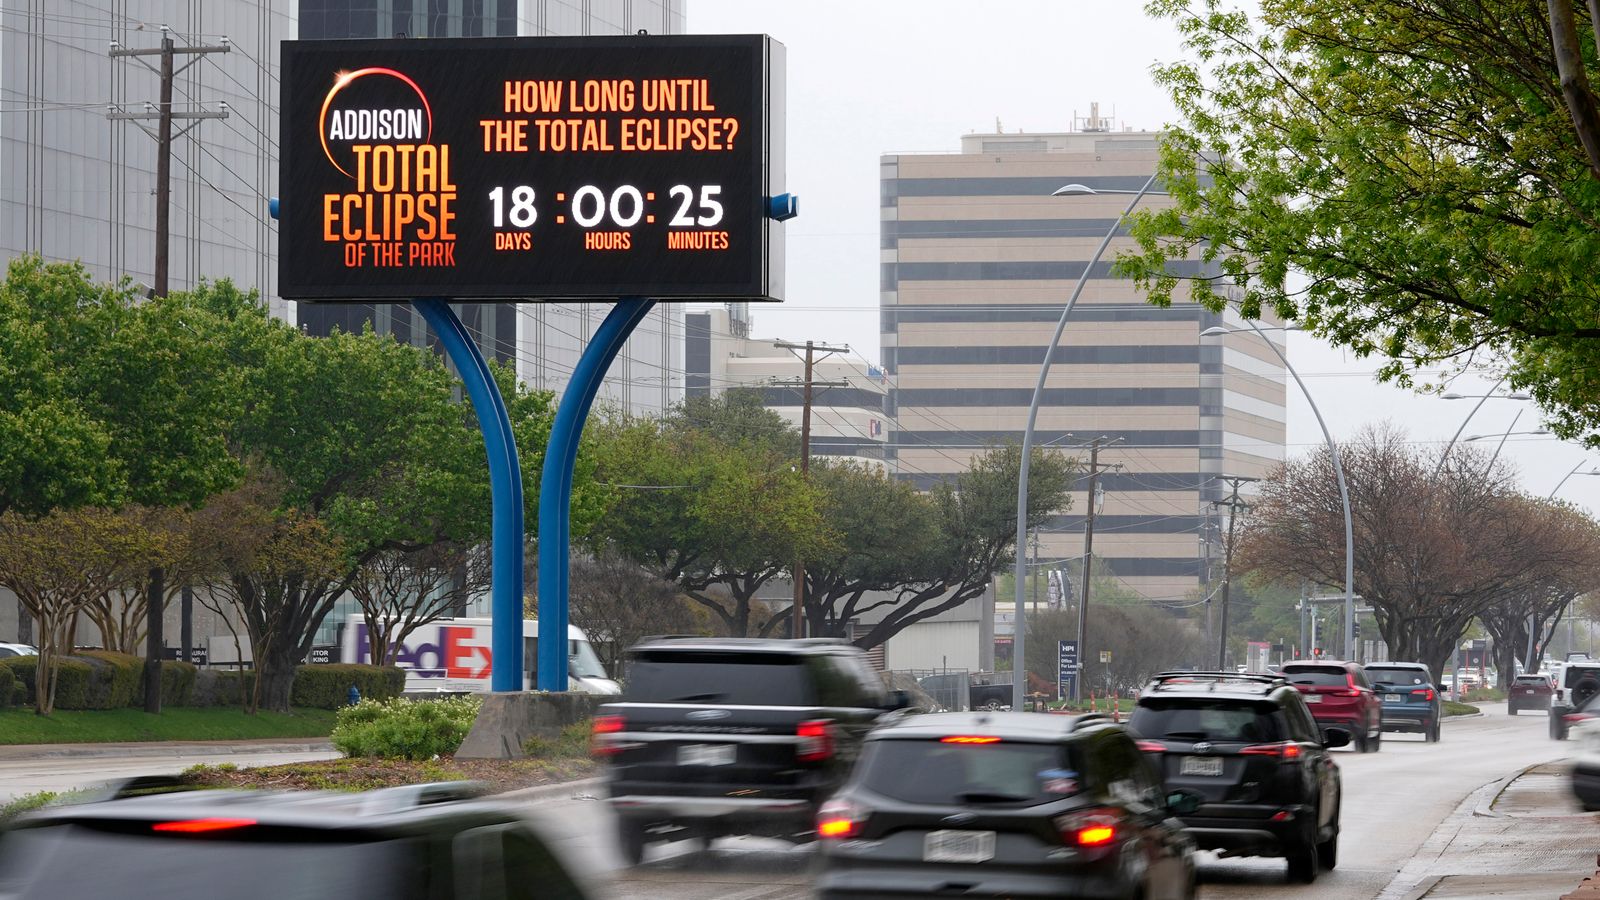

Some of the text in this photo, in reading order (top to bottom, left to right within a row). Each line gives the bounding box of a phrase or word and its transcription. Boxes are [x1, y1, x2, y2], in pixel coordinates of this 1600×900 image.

[505, 79, 716, 113] HOW LONG UNTIL
[329, 108, 422, 140] ADDISON
[479, 117, 739, 152] THE TOTAL ECLIPSE?
[352, 143, 457, 193] TOTAL
[323, 193, 457, 242] ECLIPSE
[488, 185, 538, 228] 18
[668, 184, 724, 227] 25
[344, 241, 456, 268] OF THE PARK
[495, 231, 531, 251] DAYS
[585, 231, 631, 250] HOURS
[668, 230, 729, 250] MINUTES
